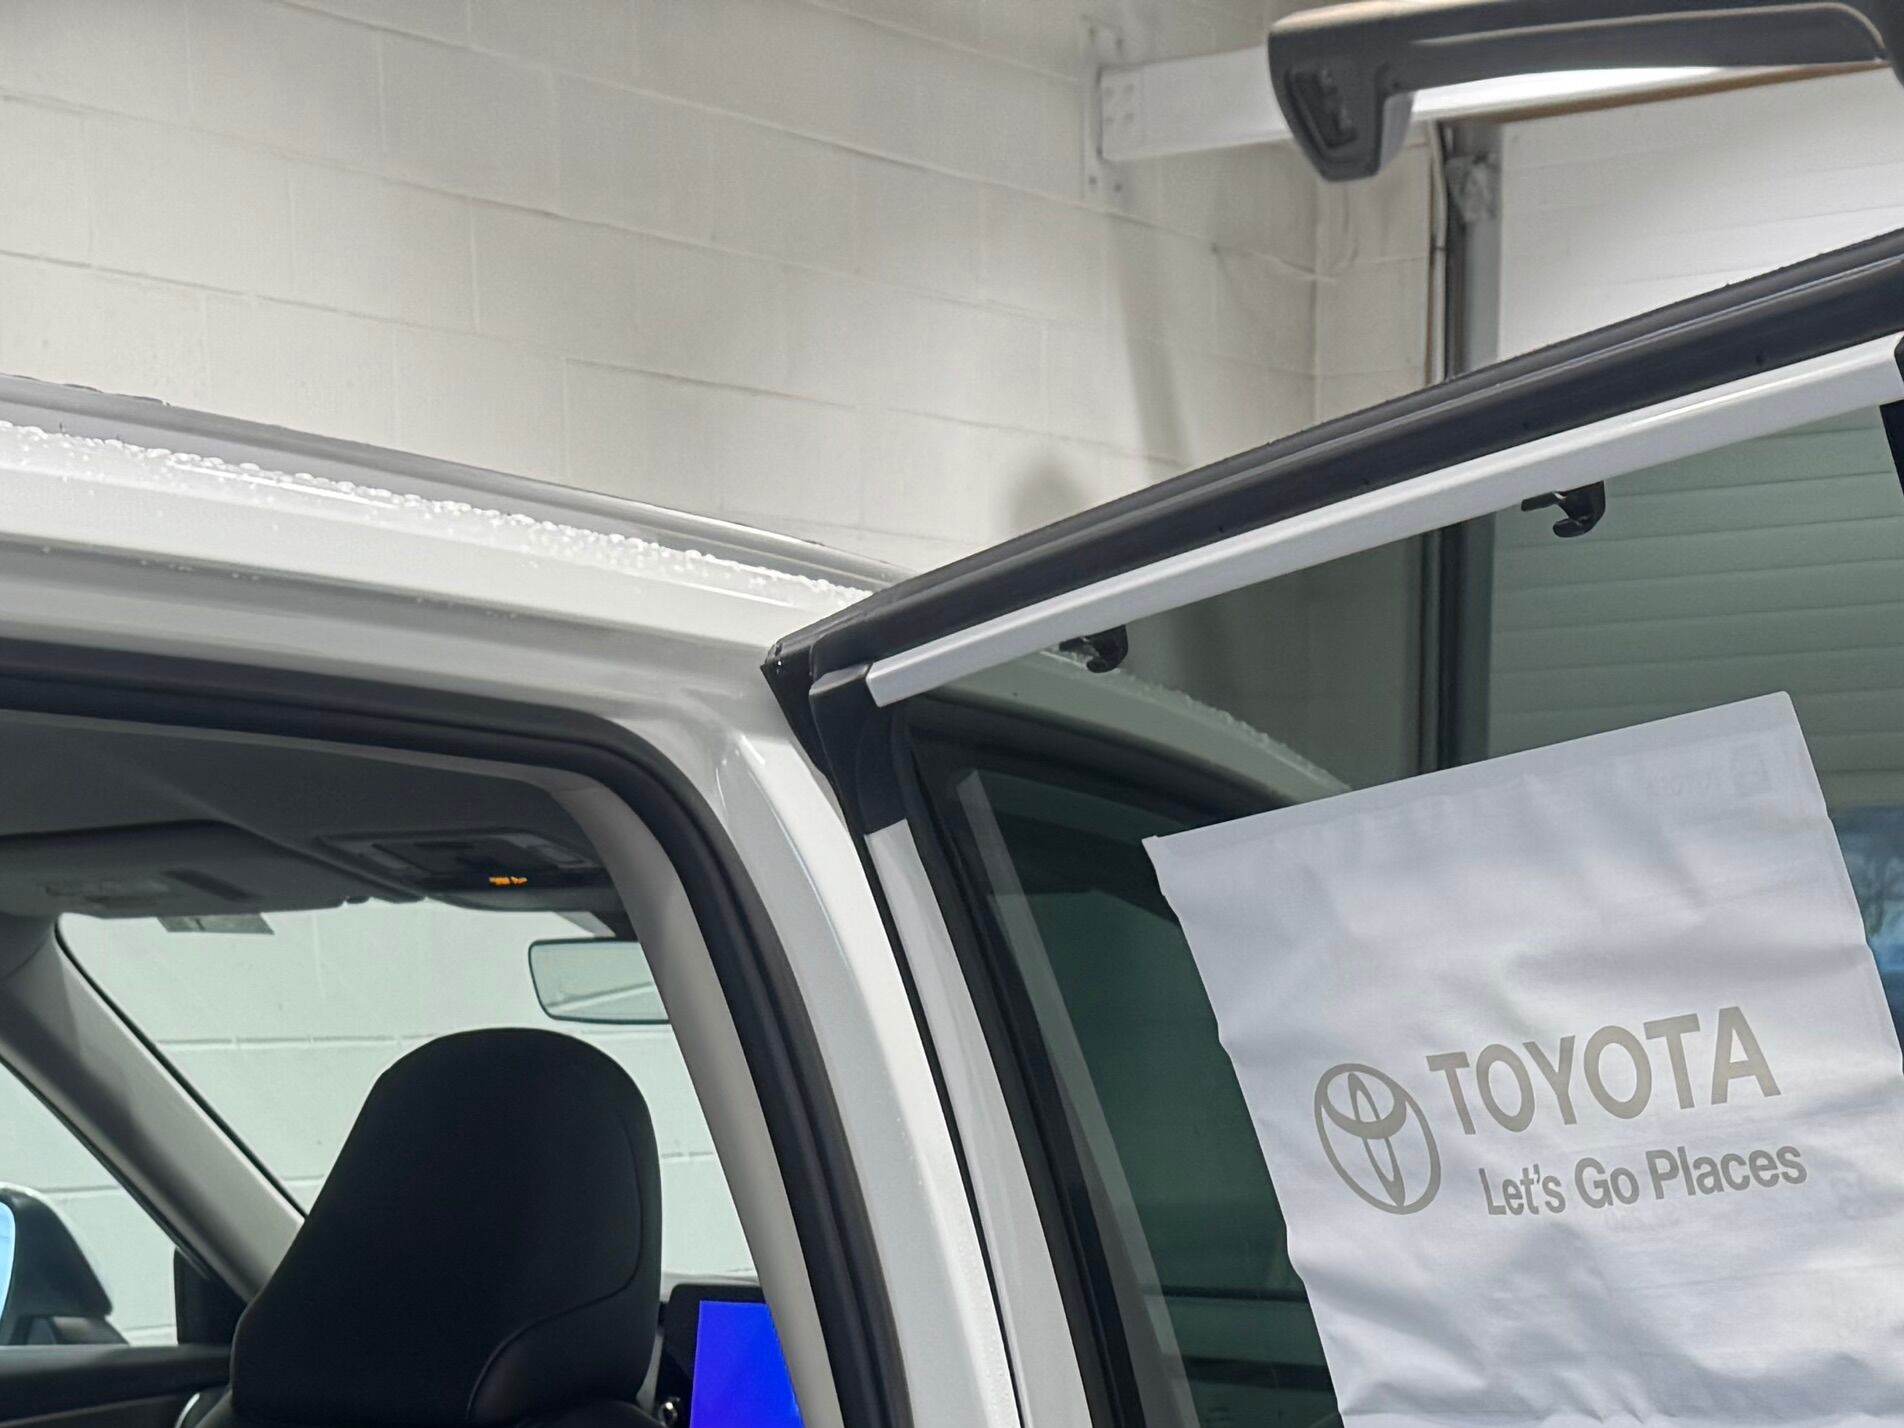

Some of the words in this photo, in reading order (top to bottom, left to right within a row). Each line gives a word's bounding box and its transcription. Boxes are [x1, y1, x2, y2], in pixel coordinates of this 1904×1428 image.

[1426, 1006, 1782, 1135] TOYOTA
[1478, 1163, 1566, 1216] Let's
[1574, 1156, 1640, 1209] Go
[1645, 1145, 1808, 1200] Places
